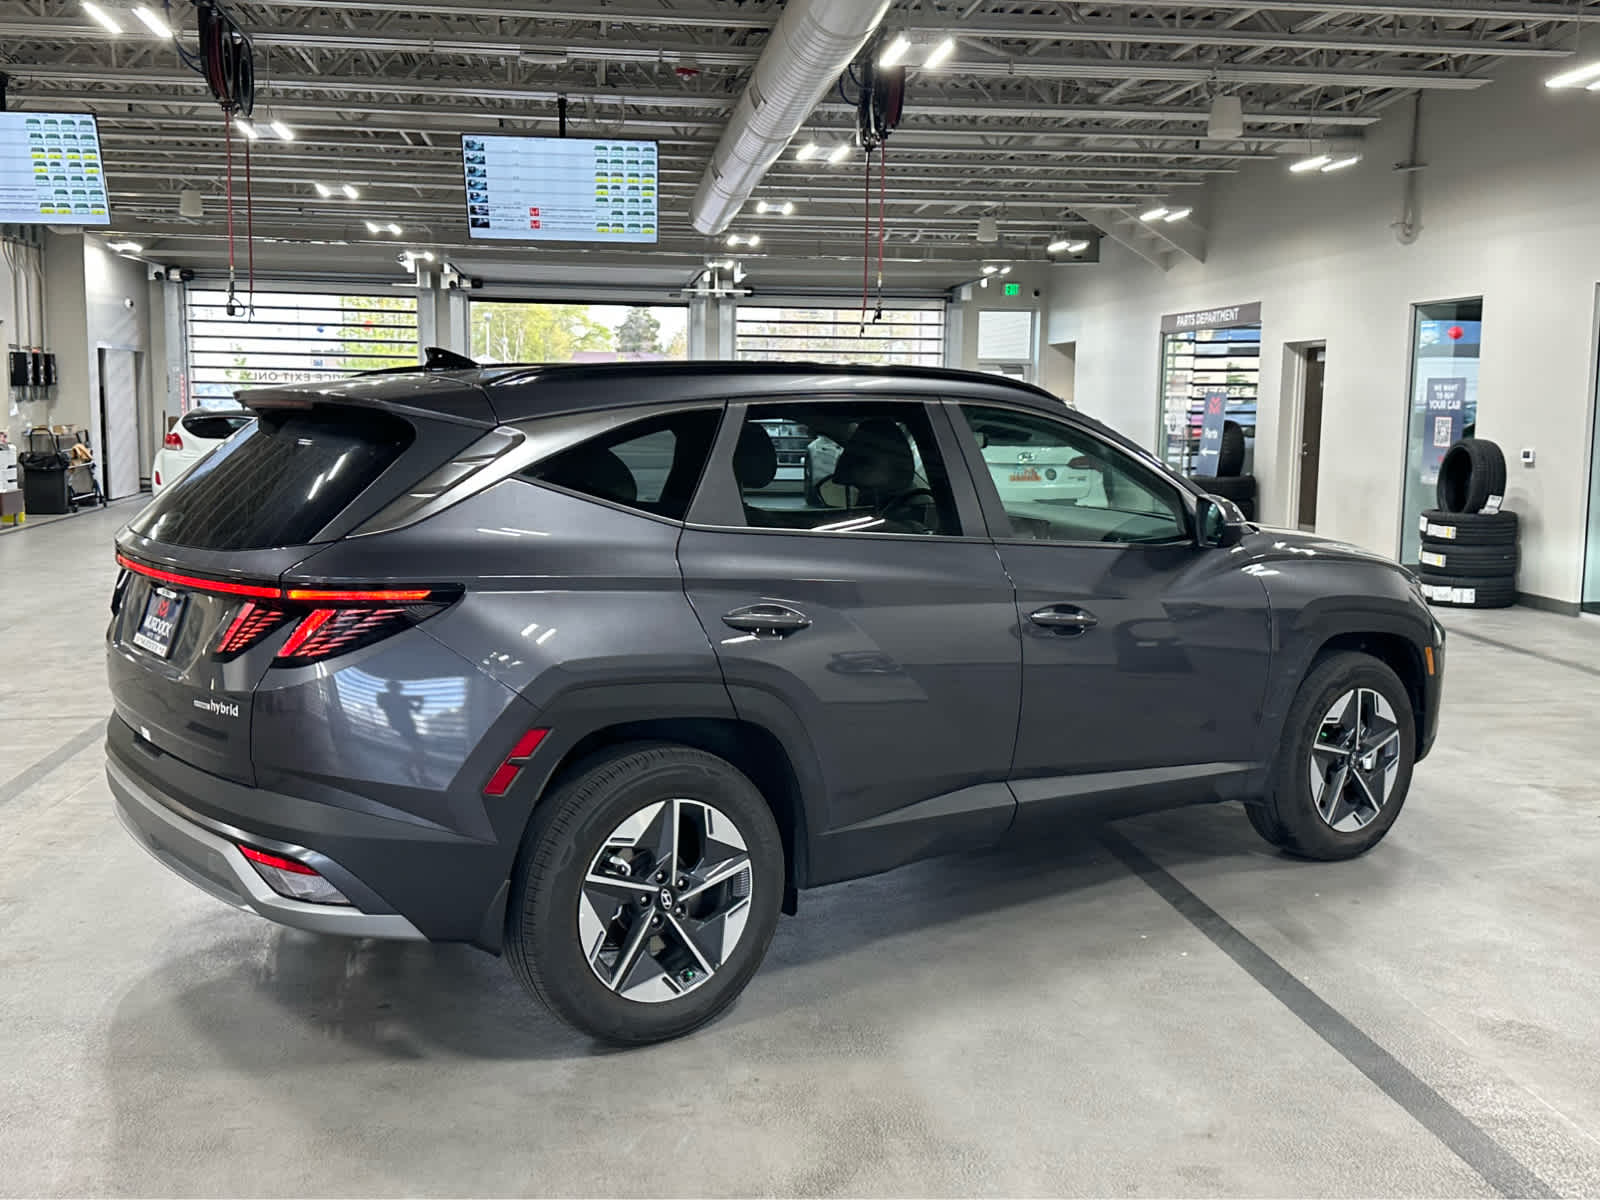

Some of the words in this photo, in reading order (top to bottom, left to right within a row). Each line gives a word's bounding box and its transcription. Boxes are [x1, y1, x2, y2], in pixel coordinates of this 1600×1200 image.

[1176, 313, 1195, 327] PARTS
[1196, 307, 1240, 325] DEPARTMENT
[1429, 400, 1446, 410] YOUR
[1447, 399, 1461, 410] CAR
[210, 698, 239, 717] hybrid
